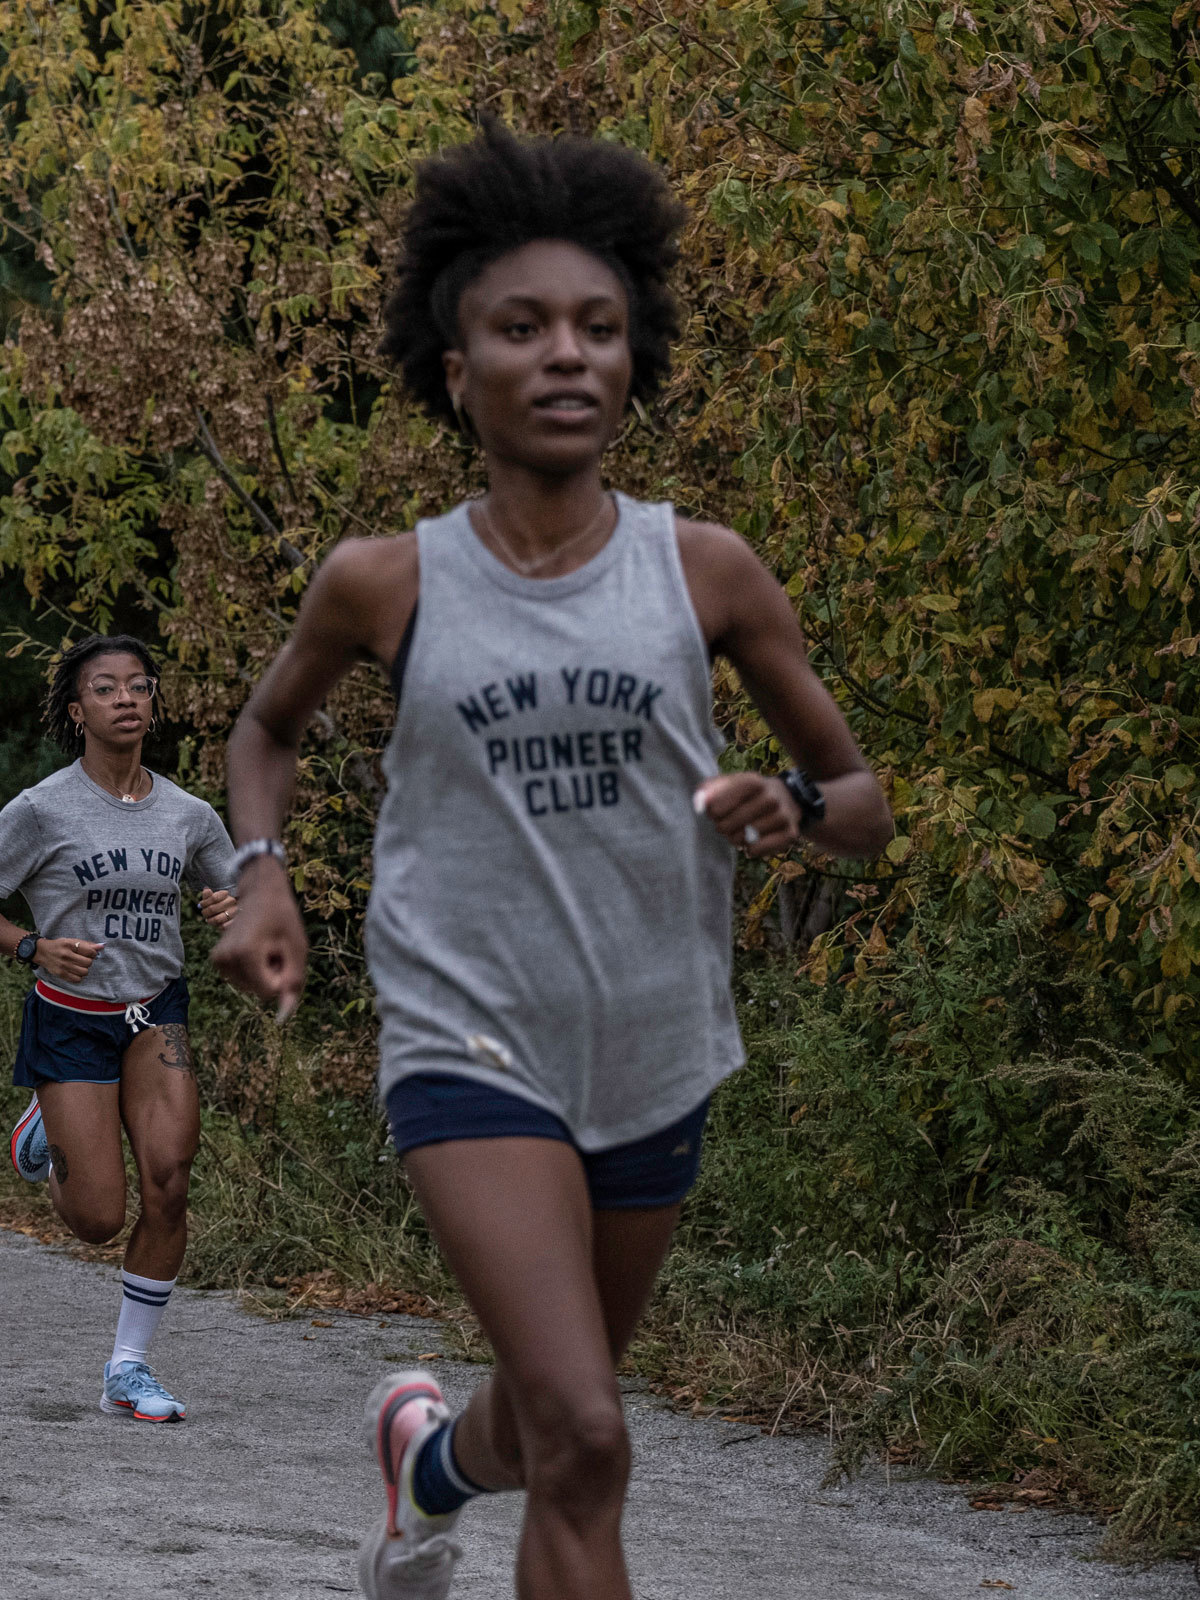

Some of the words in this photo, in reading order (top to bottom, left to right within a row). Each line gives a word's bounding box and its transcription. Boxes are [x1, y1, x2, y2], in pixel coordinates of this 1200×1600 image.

[456, 671, 538, 735] NEW
[560, 667, 663, 721] YORK
[486, 728, 643, 776] PIONEER
[525, 771, 619, 817] CLUB
[72, 848, 128, 887] NEW
[140, 848, 181, 883] YOR
[86, 888, 177, 916] PIONEER
[104, 914, 162, 943] CLUB
